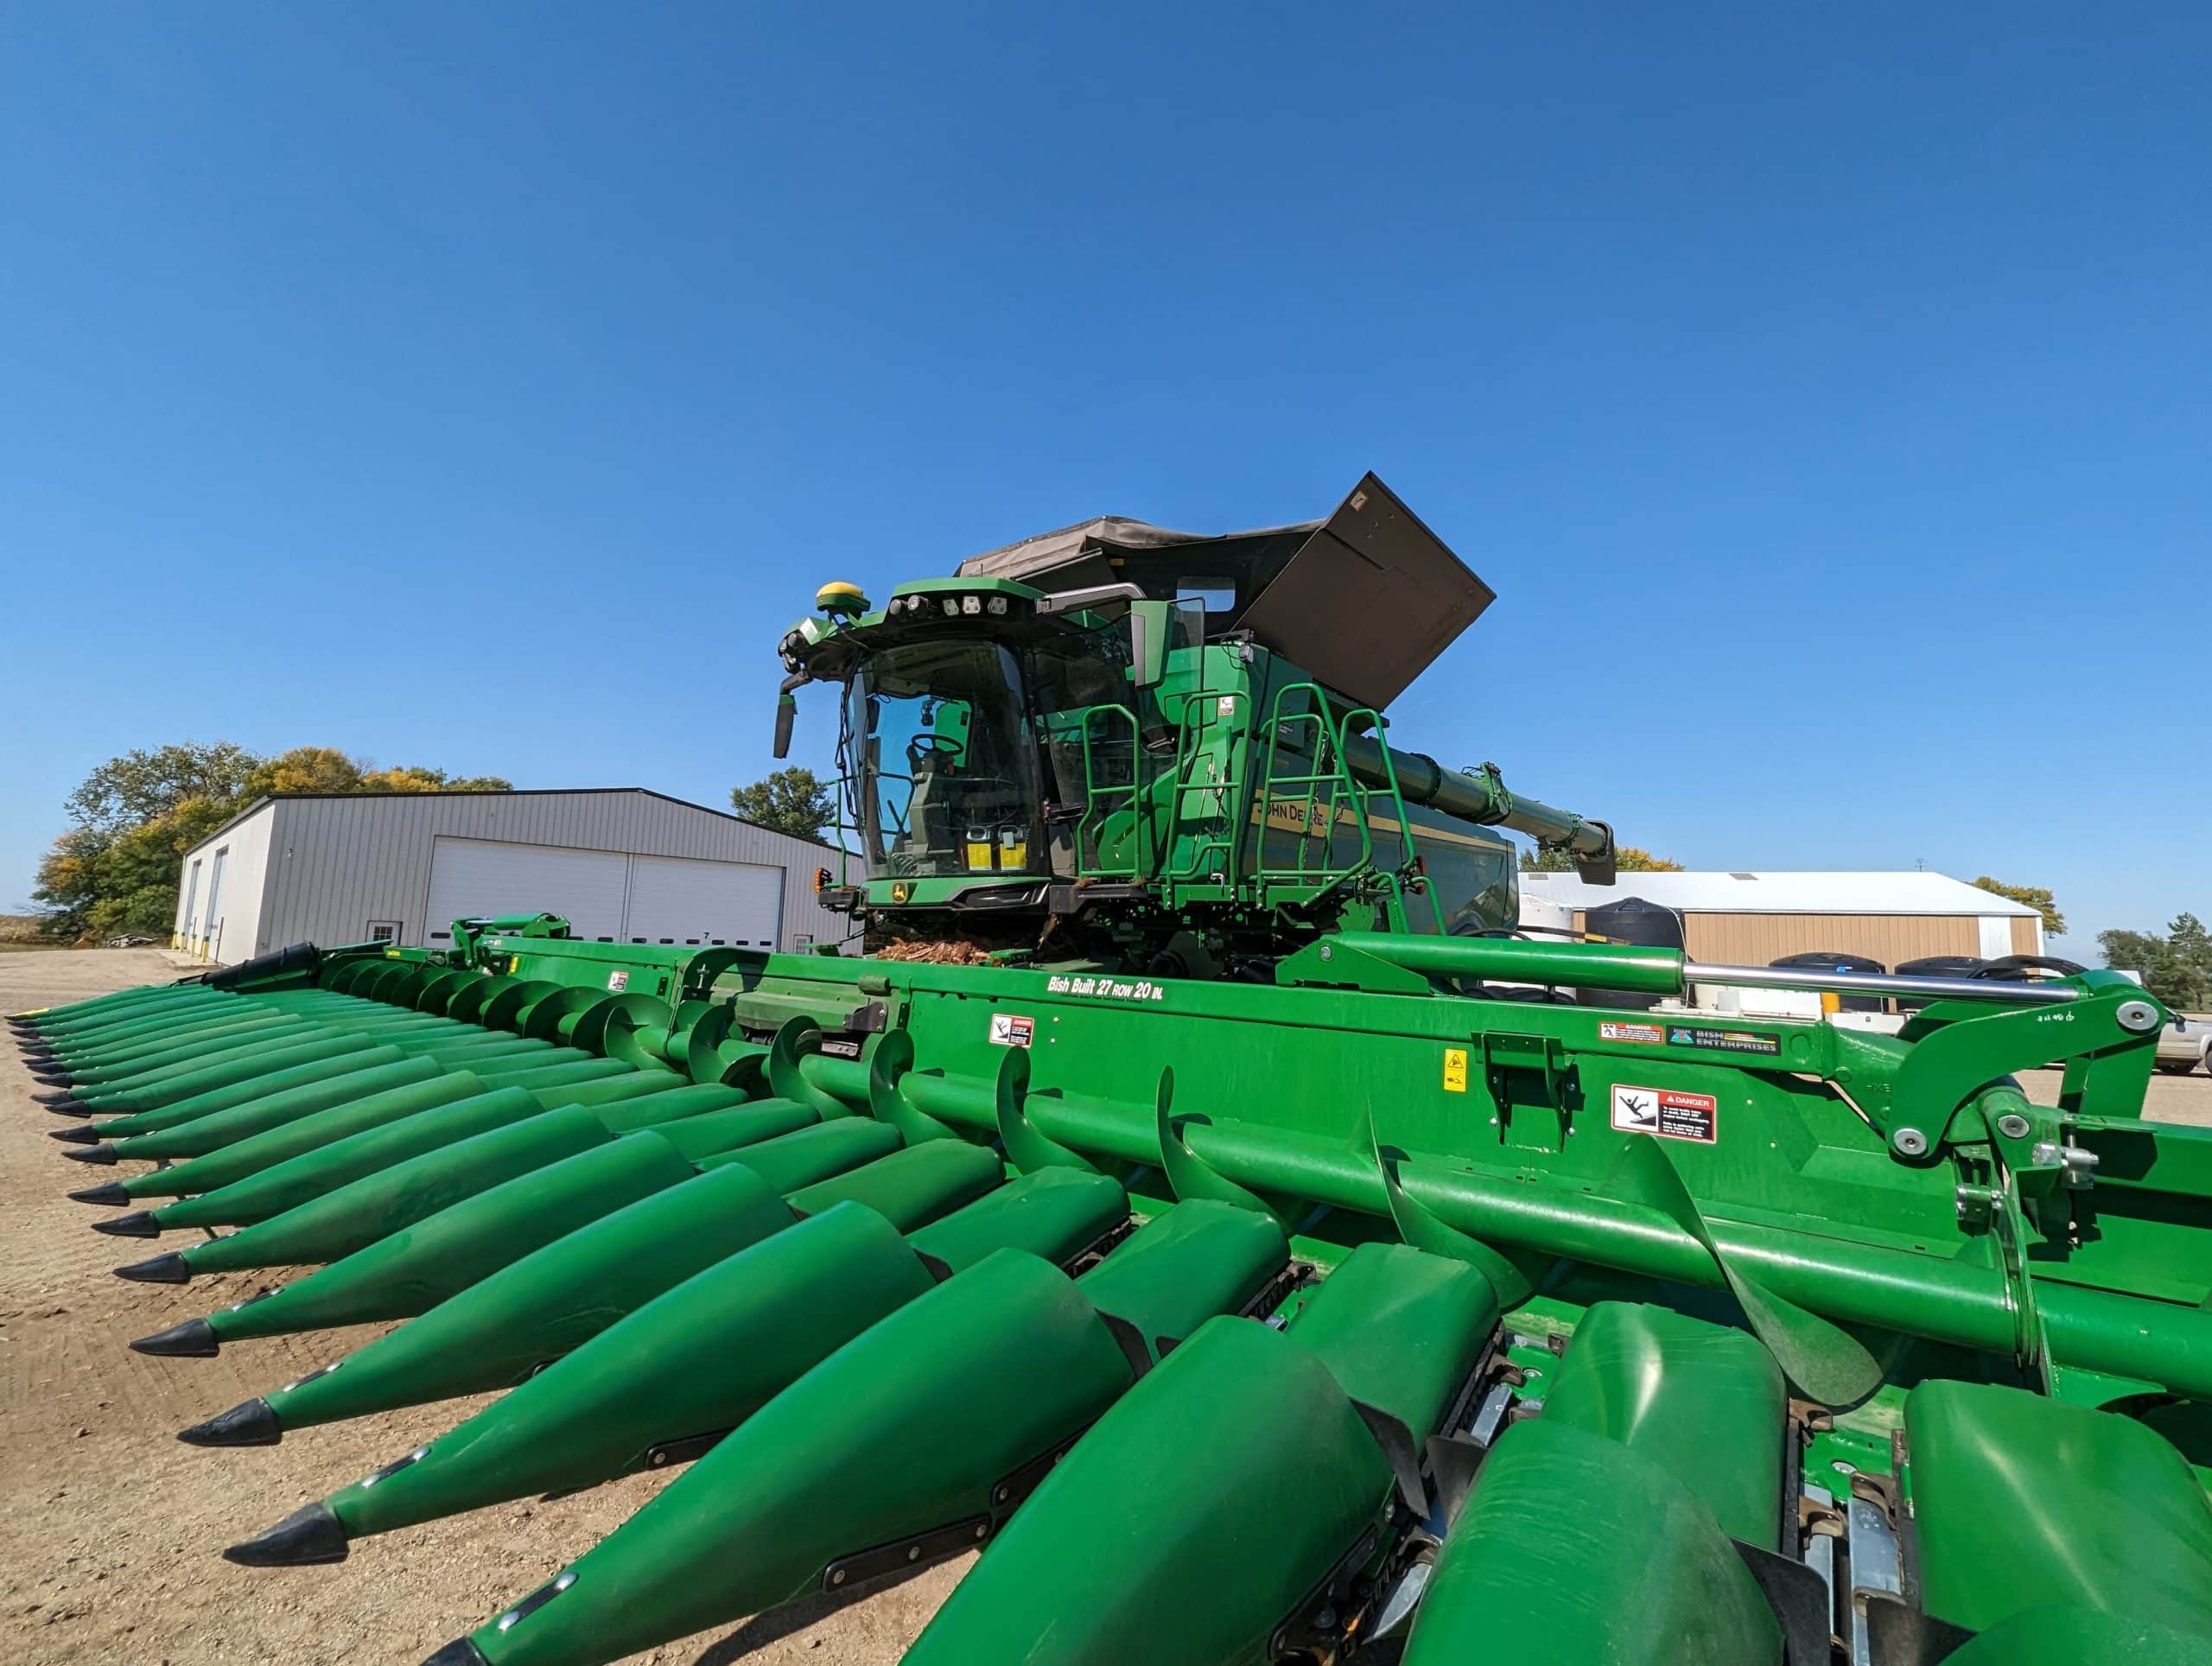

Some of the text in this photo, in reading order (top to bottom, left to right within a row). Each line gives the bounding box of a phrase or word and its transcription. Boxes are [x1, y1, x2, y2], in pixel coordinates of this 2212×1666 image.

[1257, 803, 1323, 826] OHN DERE
[1047, 976, 1070, 992] Bish
[1071, 977, 1096, 995] Built
[1096, 979, 1114, 995] 27
[1111, 983, 1134, 998] ROW
[1133, 982, 1152, 999] 20
[1696, 1029, 1724, 1040] BISH
[1696, 1038, 1777, 1052] ENTERPRISES
[1675, 1097, 1710, 1108] DANGER
